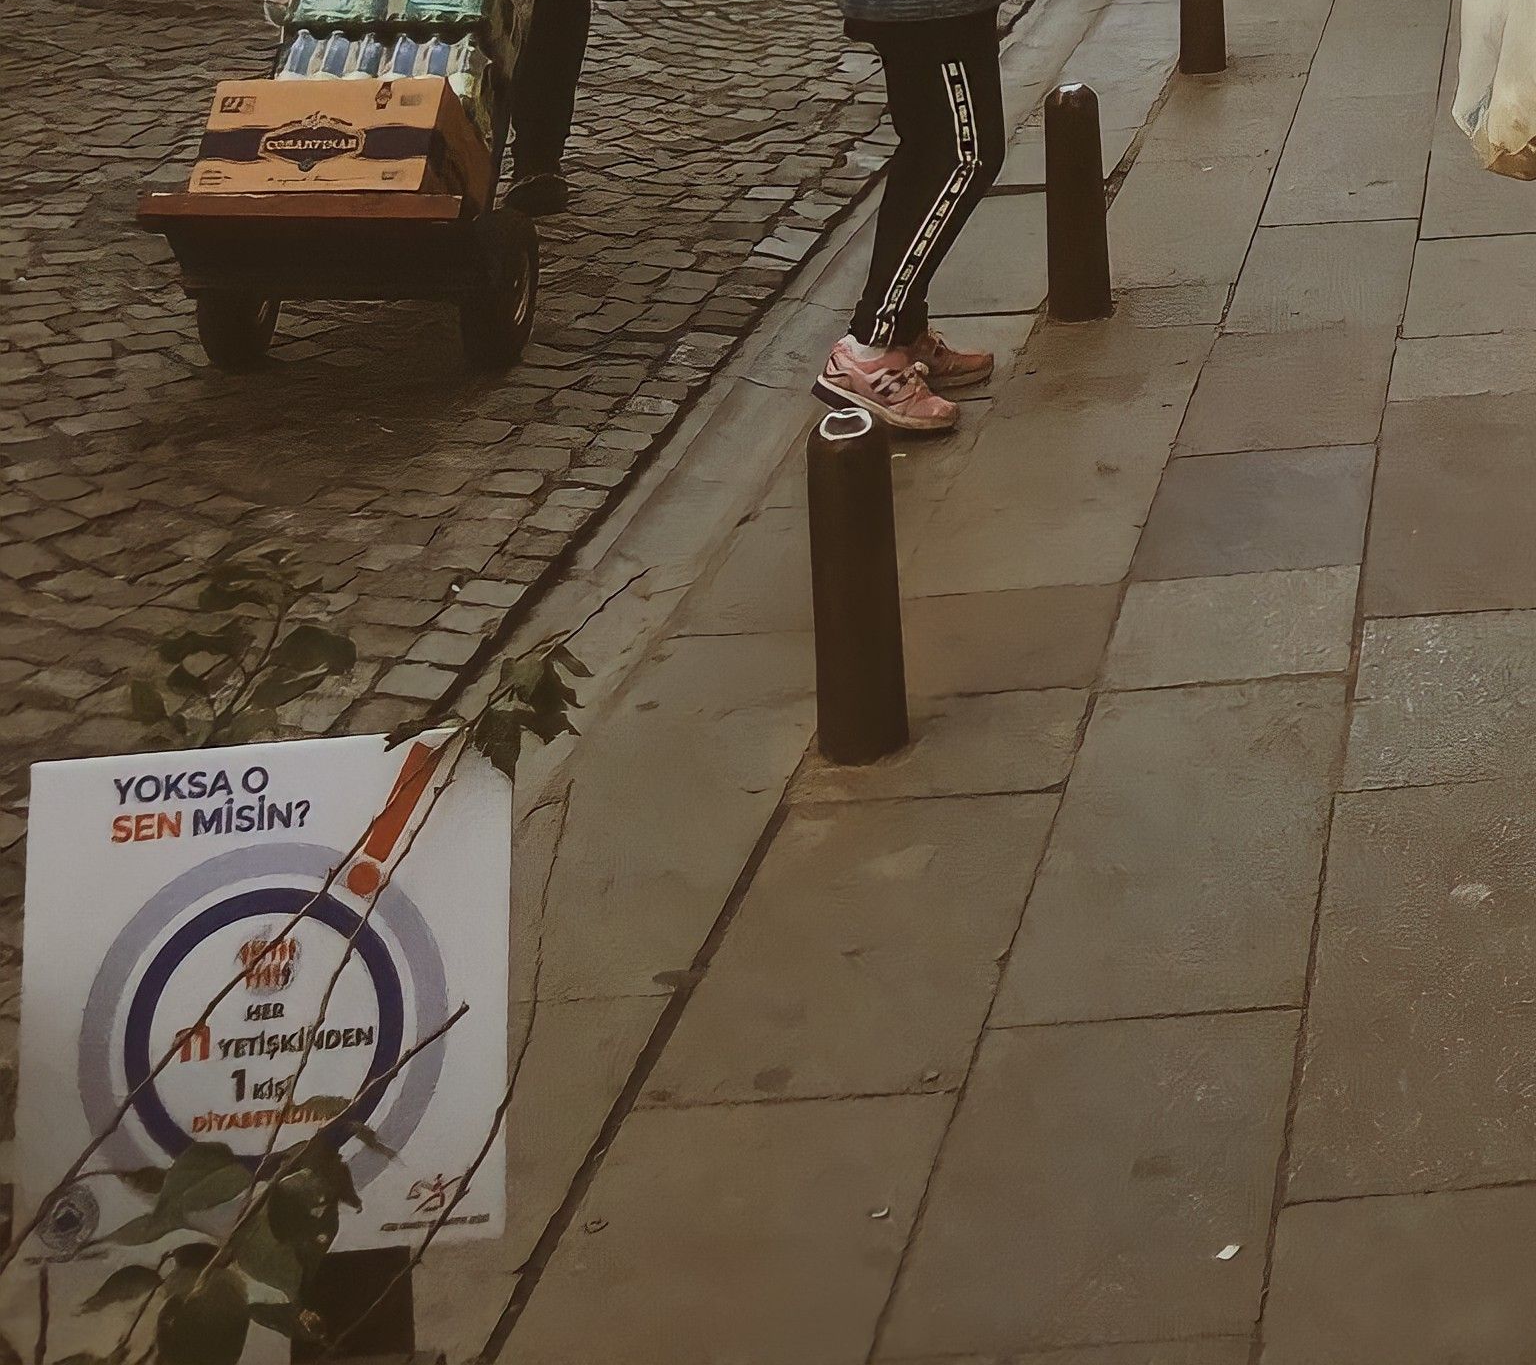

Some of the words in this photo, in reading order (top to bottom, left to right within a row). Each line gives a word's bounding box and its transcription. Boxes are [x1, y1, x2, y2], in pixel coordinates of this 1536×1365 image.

[113, 770, 234, 806] YOKSA
[241, 766, 270, 795] O
[111, 810, 183, 843] SEN
[192, 794, 311, 837] MİSİN?
[230, 1068, 247, 1103] 1
